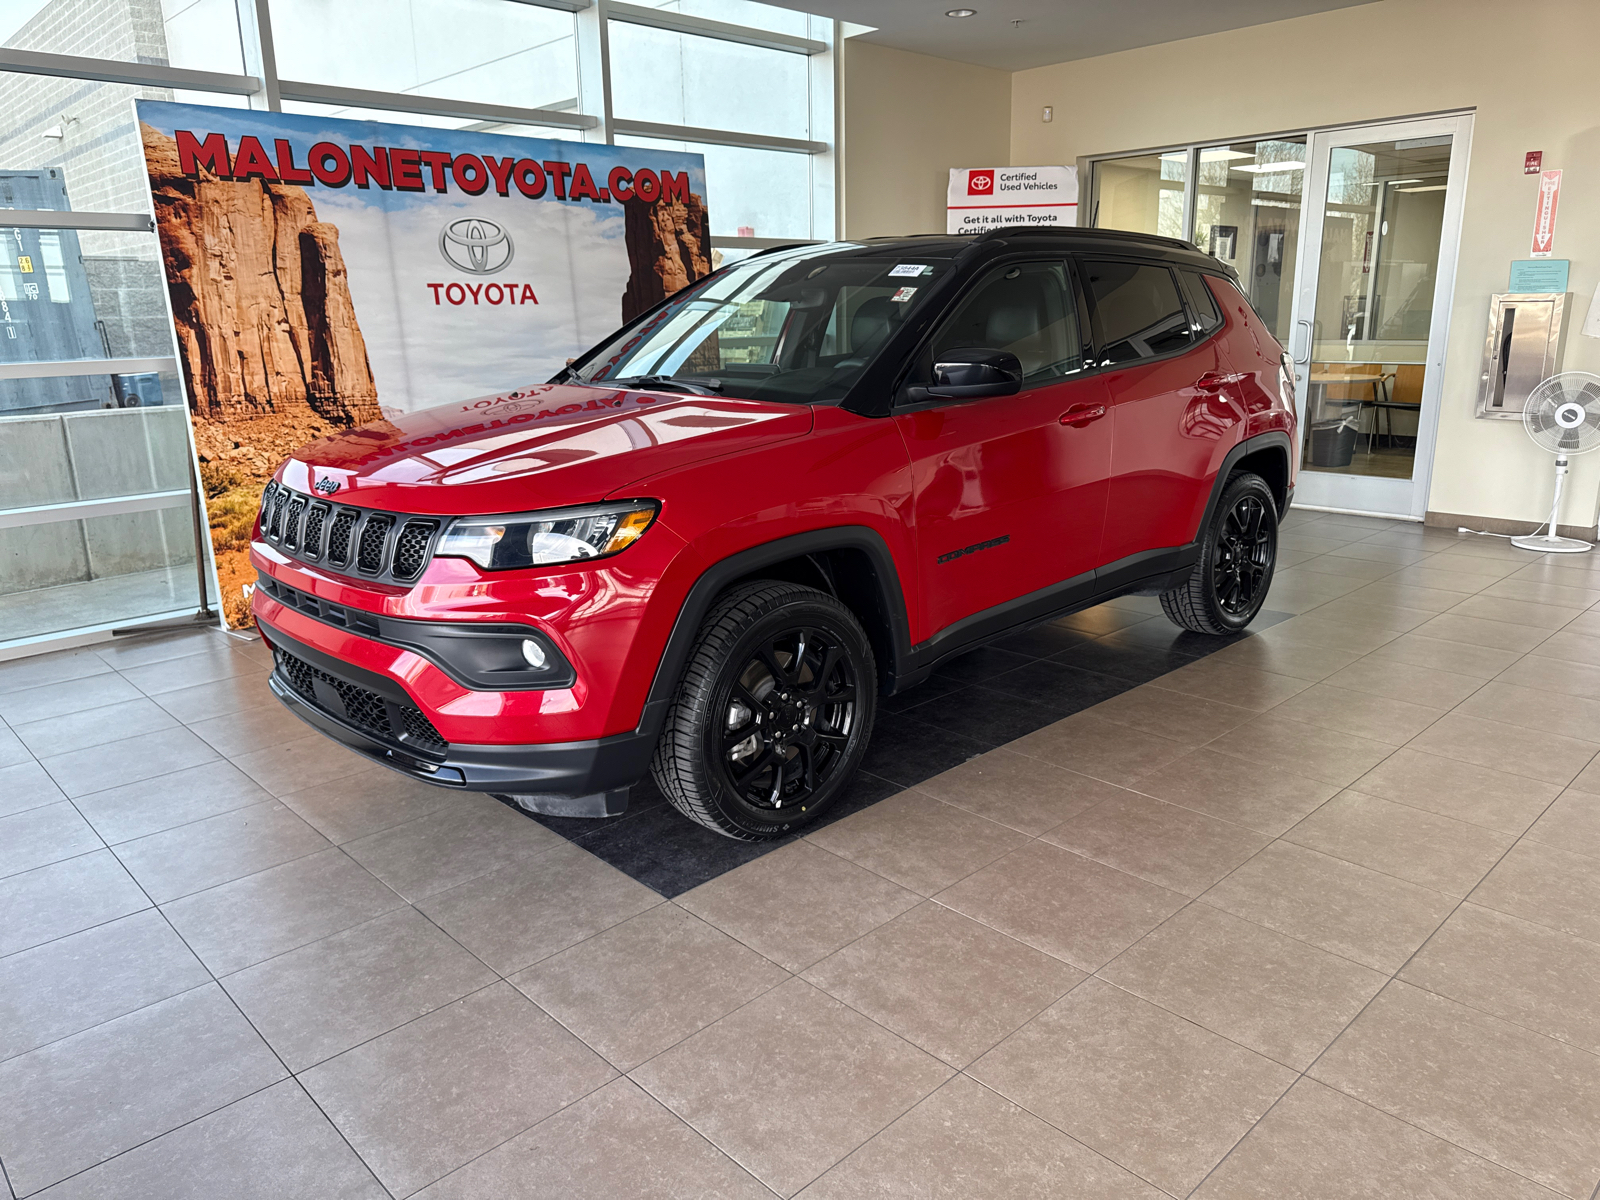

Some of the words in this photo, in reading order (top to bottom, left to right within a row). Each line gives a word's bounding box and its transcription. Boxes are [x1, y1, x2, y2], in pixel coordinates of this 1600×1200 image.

[175, 130, 691, 205] MALONETOYOTA.COM
[1000, 172, 1037, 182] Certified
[1000, 183, 1022, 191] Used
[1023, 182, 1058, 190] Vehicles
[963, 216, 980, 224] Get
[982, 215, 989, 223] it
[991, 215, 1003, 223] all
[1004, 214, 1025, 222] with
[1027, 214, 1058, 224] Toyota
[1540, 186, 1552, 244] EXTINGUISHER
[957, 226, 998, 235] Certifie
[427, 282, 539, 306] TOYOTA
[314, 475, 342, 496] Jeep
